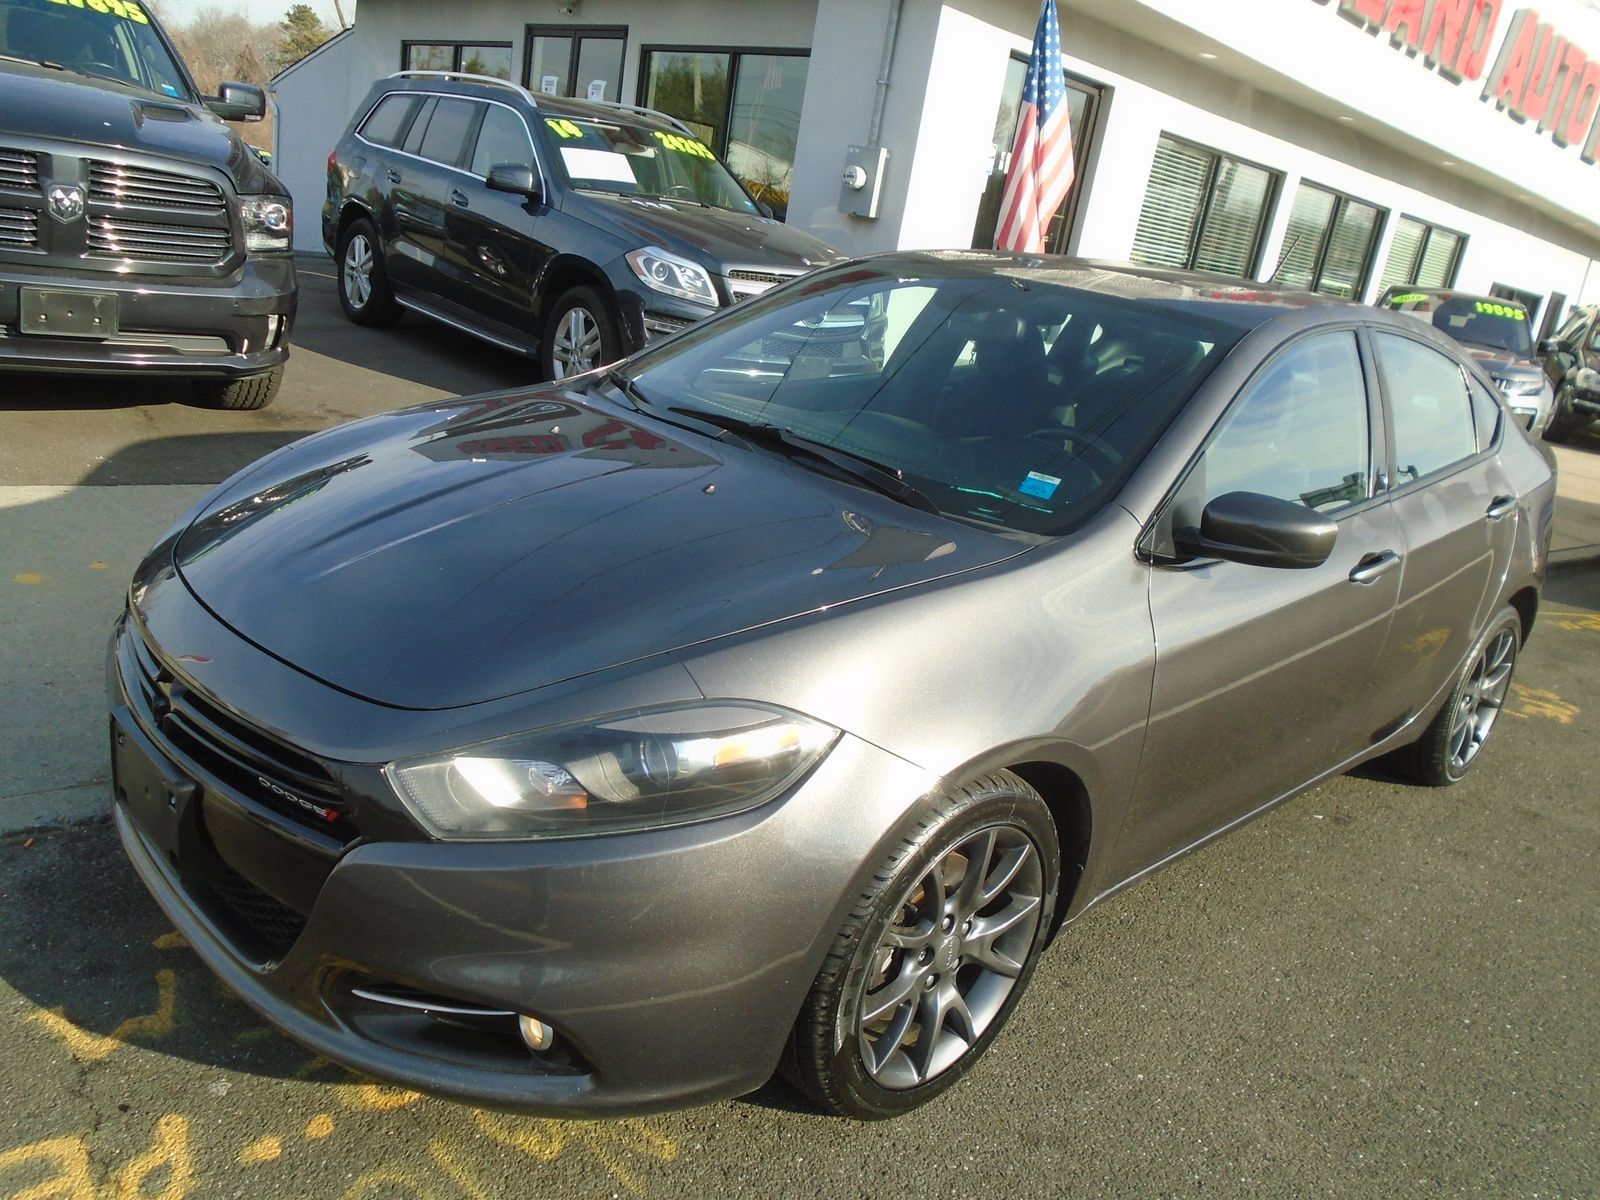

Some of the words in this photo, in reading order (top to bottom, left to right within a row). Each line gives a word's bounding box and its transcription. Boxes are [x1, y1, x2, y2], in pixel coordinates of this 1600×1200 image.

[1480, 8, 1600, 148] AUTO
[1476, 301, 1525, 321] 19895
[258, 776, 328, 817] DODGE
